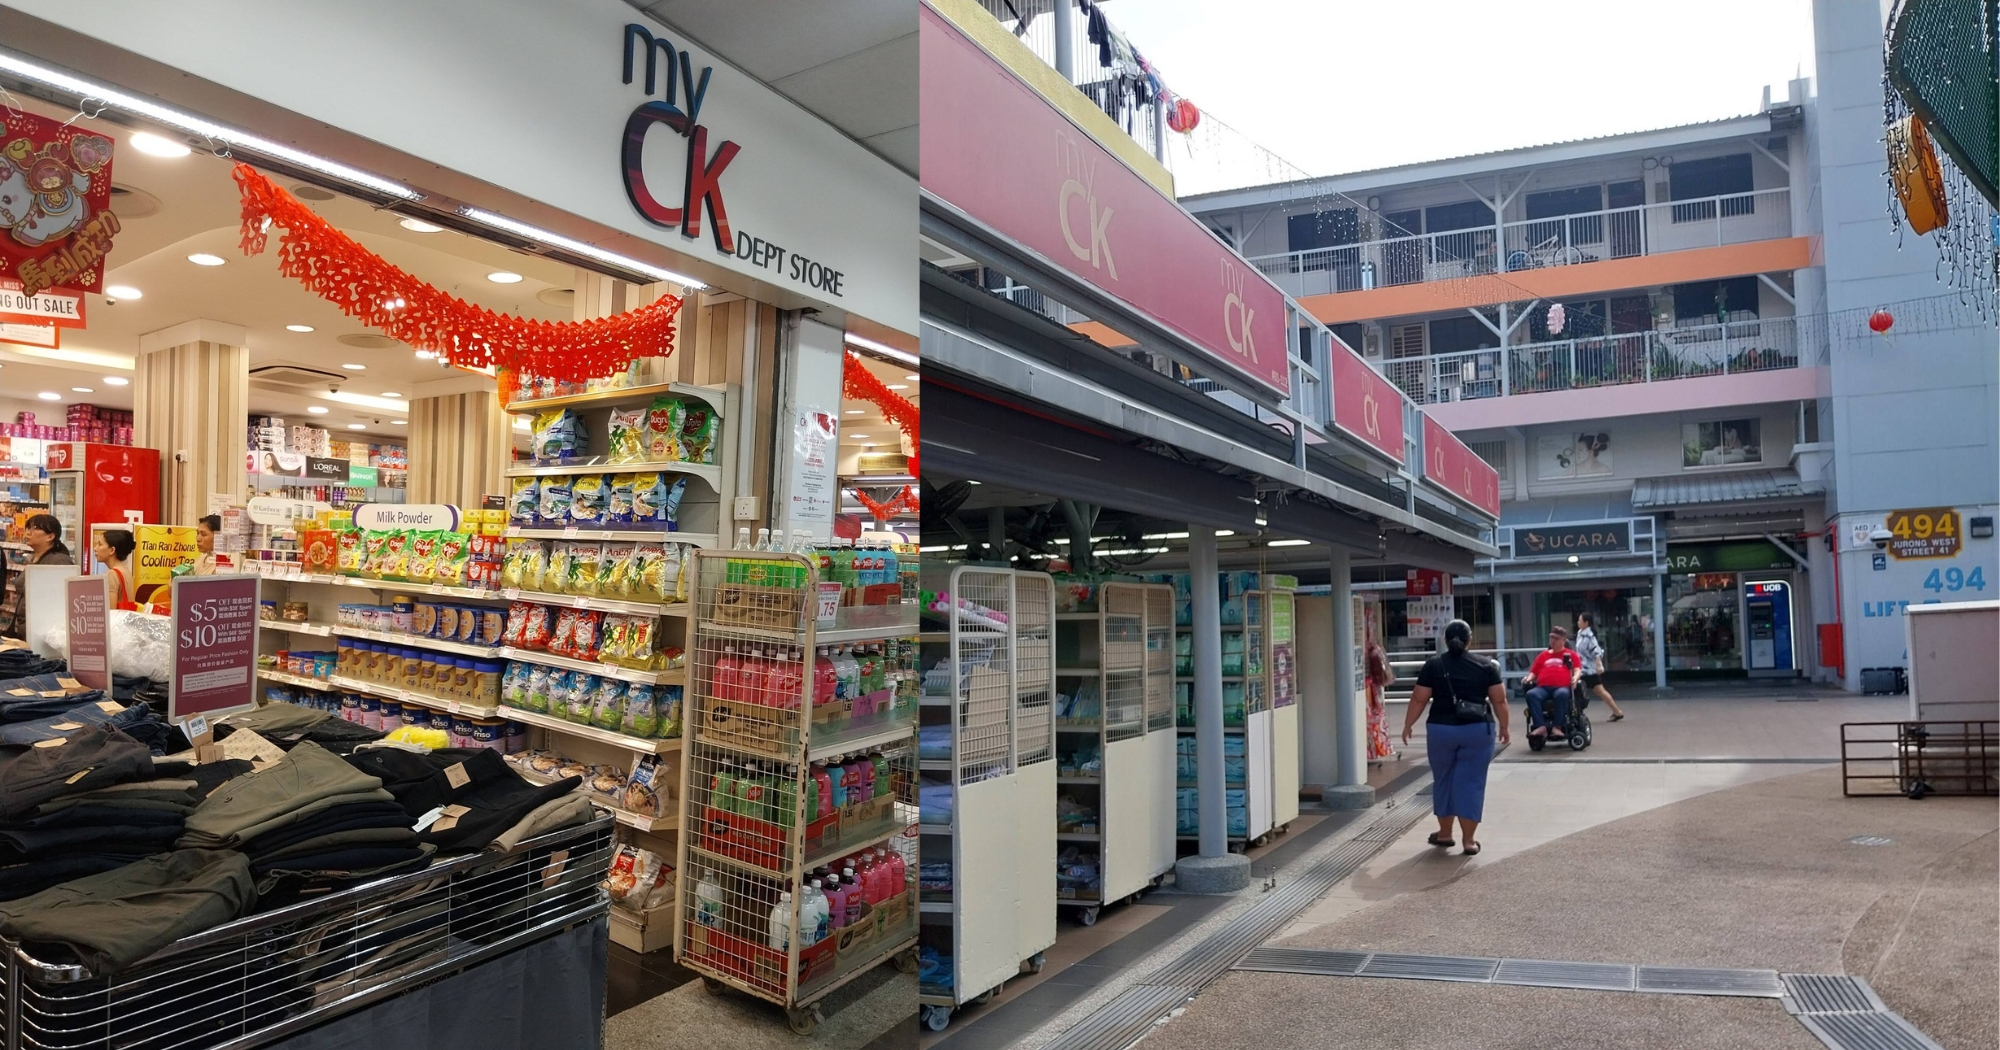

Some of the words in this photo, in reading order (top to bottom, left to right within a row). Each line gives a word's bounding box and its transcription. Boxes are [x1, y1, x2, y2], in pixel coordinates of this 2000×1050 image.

[622, 23, 713, 138] my
[621, 100, 742, 255] CK
[1055, 128, 1097, 204] my
[1059, 179, 1118, 281] CK
[737, 230, 786, 275] DEPT
[790, 253, 844, 298] STORE
[1220, 257, 1244, 309] my
[17, 296, 39, 311] OUT
[44, 298, 73, 315] SALE
[1224, 292, 1258, 364] CK
[1364, 394, 1381, 441] CK
[1434, 446, 1446, 481] CK
[376, 511, 395, 523] Milk
[397, 512, 433, 524] Powder
[1892, 513, 1955, 539] 494
[142, 541, 157, 551] Tian
[159, 541, 172, 551] Ran
[173, 542, 196, 552] Zhong
[1550, 532, 1618, 549] UCARA
[1892, 540, 1928, 549] JURONG
[1932, 537, 1956, 546] WEST
[1902, 548, 1935, 557] STREET
[141, 555, 177, 568] Cooling
[178, 556, 195, 566] Tea
[1763, 584, 1781, 592] UOB
[1923, 566, 1986, 593] 494
[190, 599, 217, 623] $5
[1864, 600, 1909, 618] LIFT
[180, 624, 217, 649] $10
[190, 654, 208, 662] Regular
[209, 652, 221, 660] Price
[221, 649, 239, 657] Fashion
